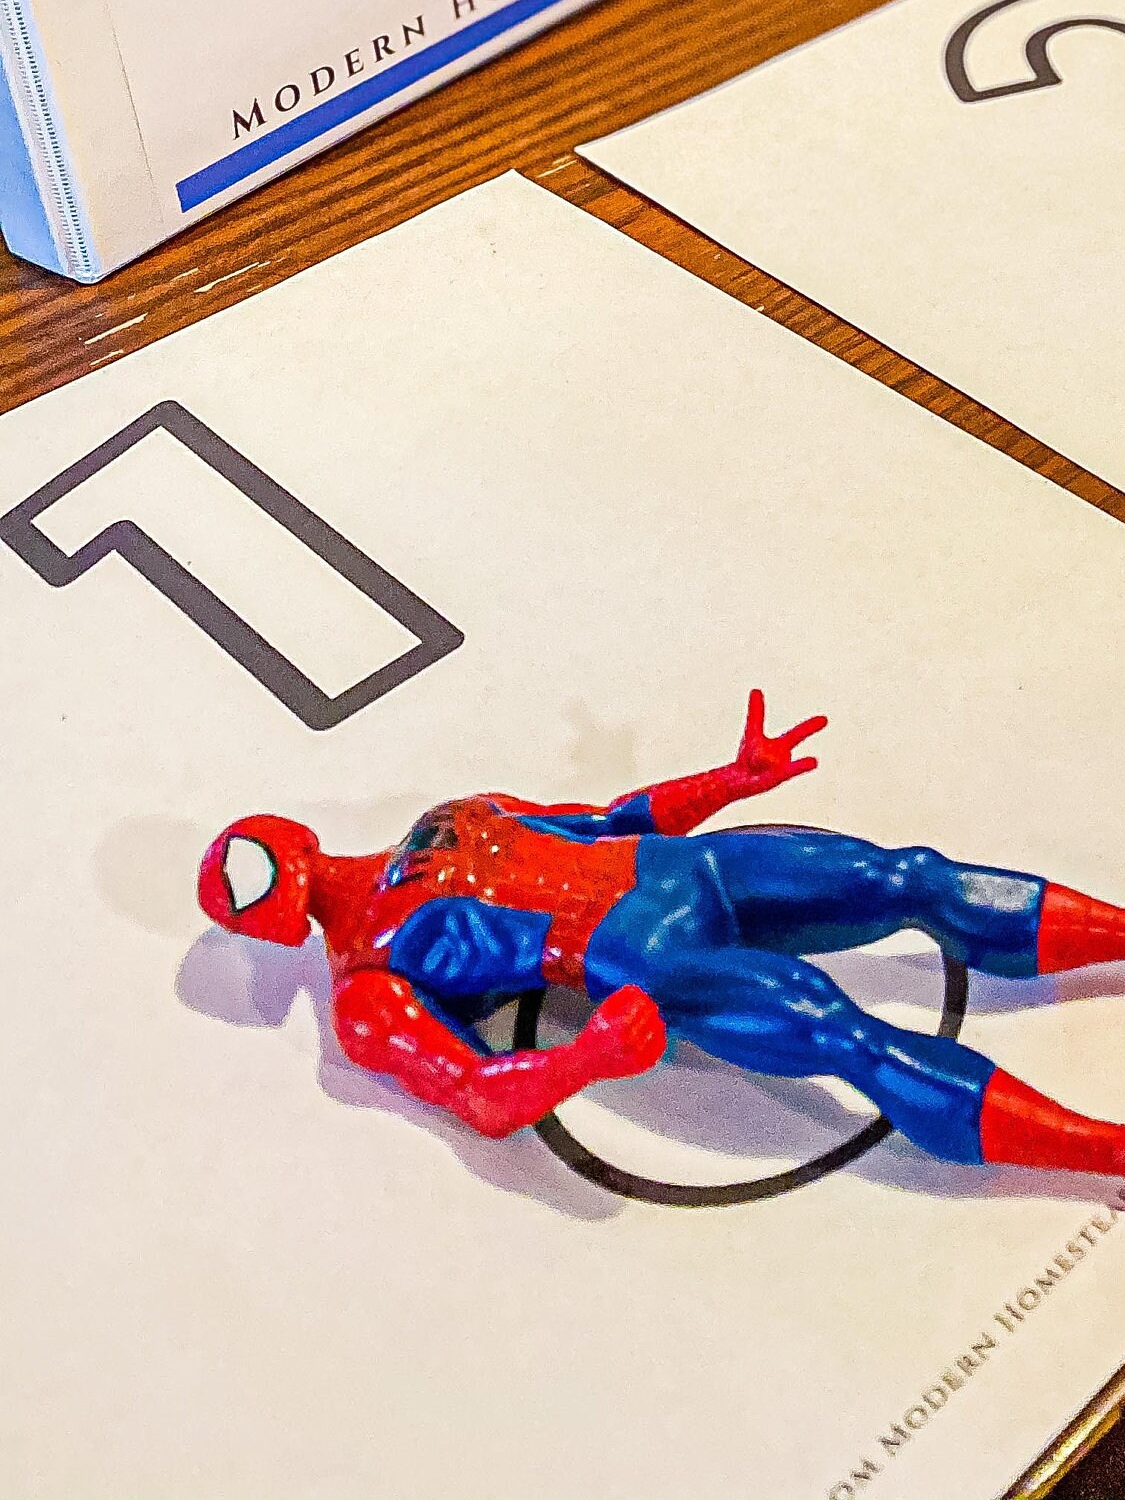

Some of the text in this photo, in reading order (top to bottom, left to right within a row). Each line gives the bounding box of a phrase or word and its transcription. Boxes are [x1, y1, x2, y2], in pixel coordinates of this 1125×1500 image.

[231, 14, 426, 141] MODERN
[0, 399, 465, 731] 1
[877, 1331, 997, 1457] MODERN
